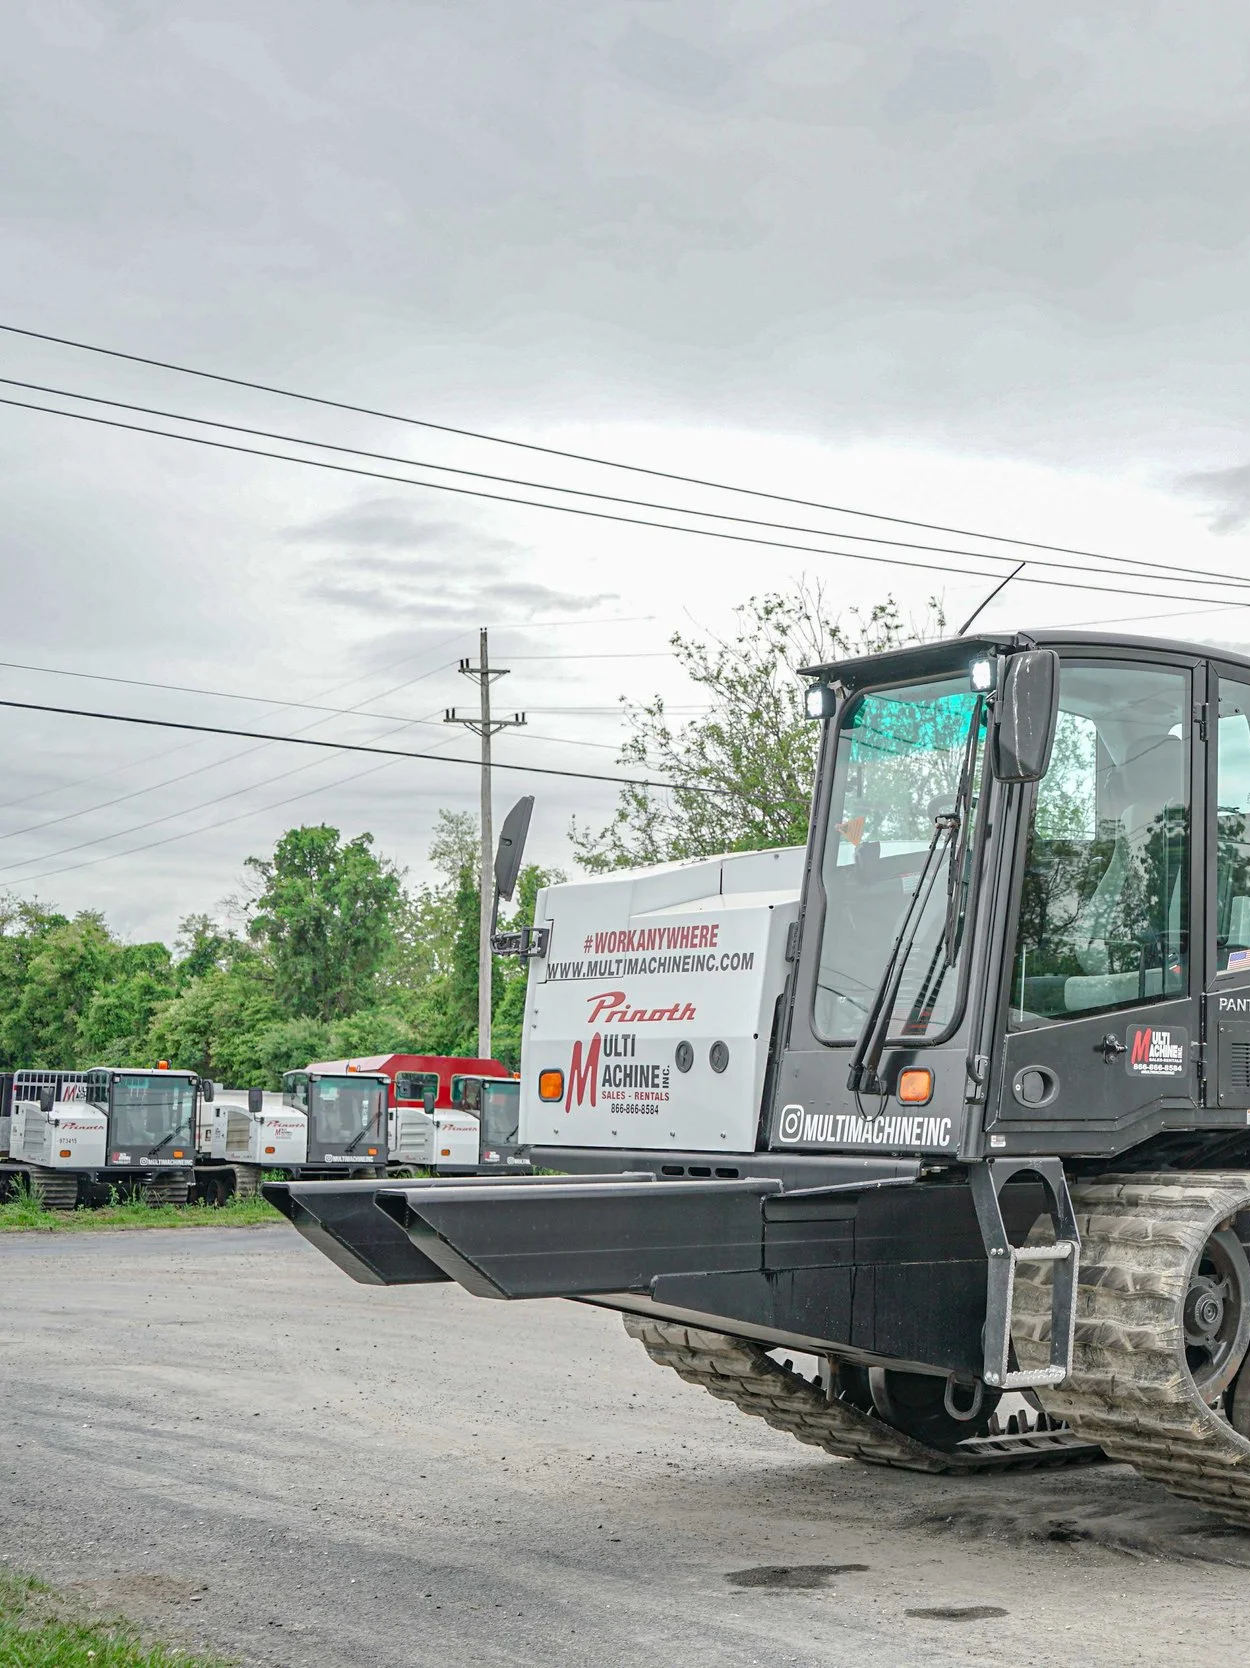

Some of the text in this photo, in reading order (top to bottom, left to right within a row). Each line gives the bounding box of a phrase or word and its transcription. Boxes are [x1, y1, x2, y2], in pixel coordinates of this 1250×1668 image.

[583, 924, 720, 954] #WORKANYWHERE
[547, 952, 754, 979] WWW.MULTIMACHINEINC.COM
[587, 991, 696, 1023] Prinoth
[662, 1065, 670, 1089] INC.
[602, 1091, 626, 1100] SALES
[634, 1092, 670, 1101] RENTALS
[611, 1103, 659, 1115] 866-866-8584
[803, 1114, 951, 1147] MULTIMACHINEINC
